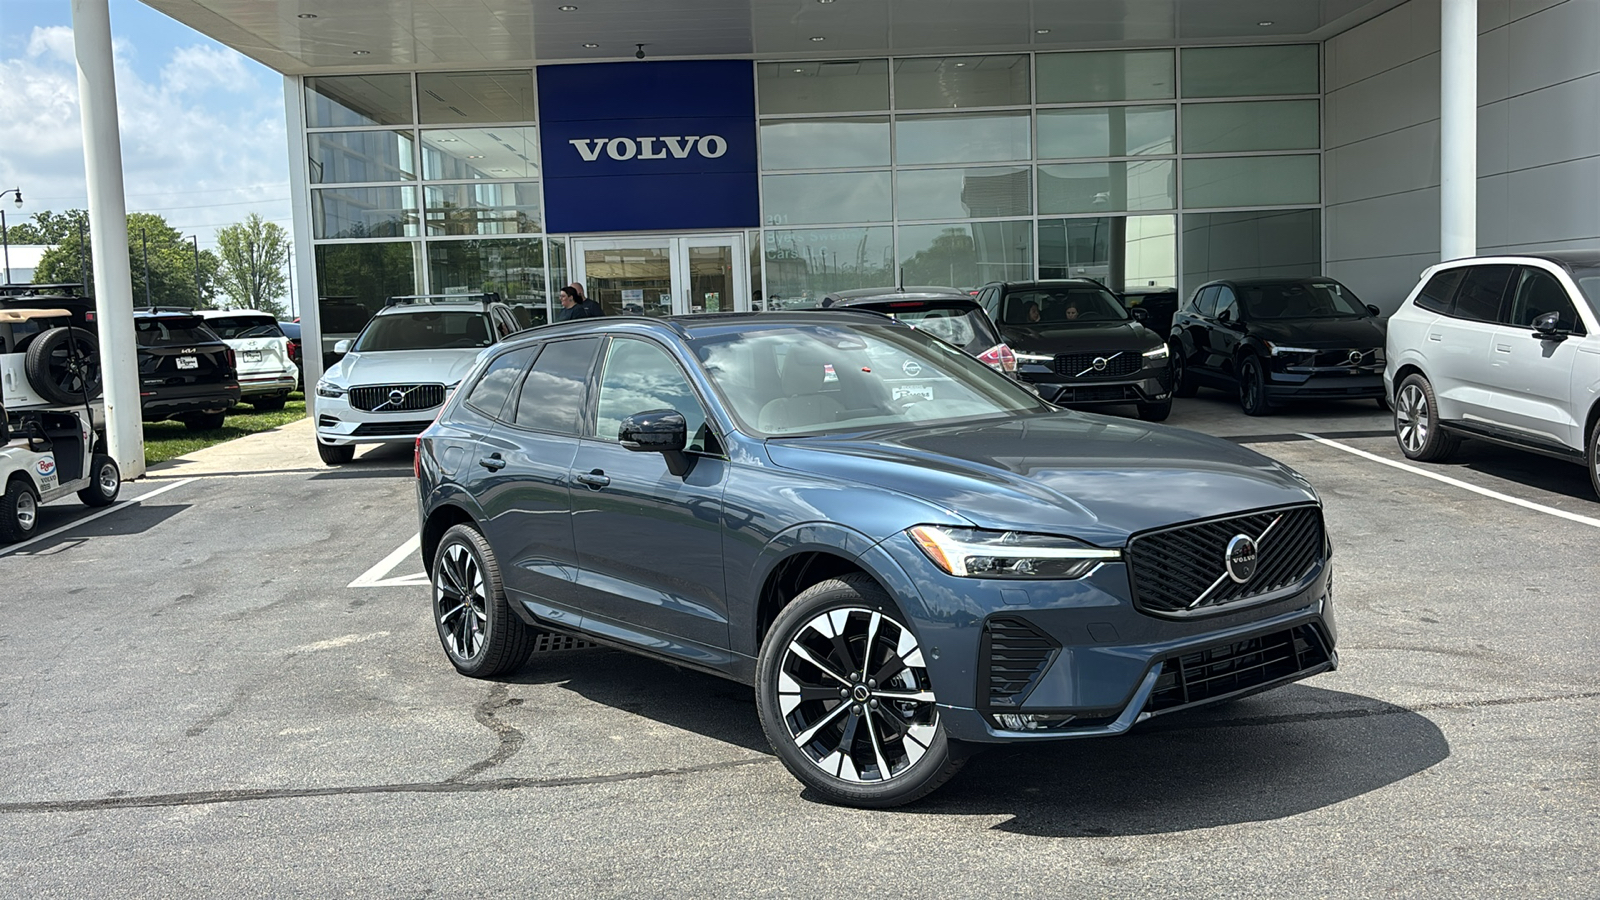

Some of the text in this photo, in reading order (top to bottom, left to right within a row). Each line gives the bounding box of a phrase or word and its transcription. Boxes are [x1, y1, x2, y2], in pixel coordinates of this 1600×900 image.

[568, 134, 728, 162] VOLVO
[767, 247, 799, 259] Cars
[1233, 554, 1256, 564] VOLVO
